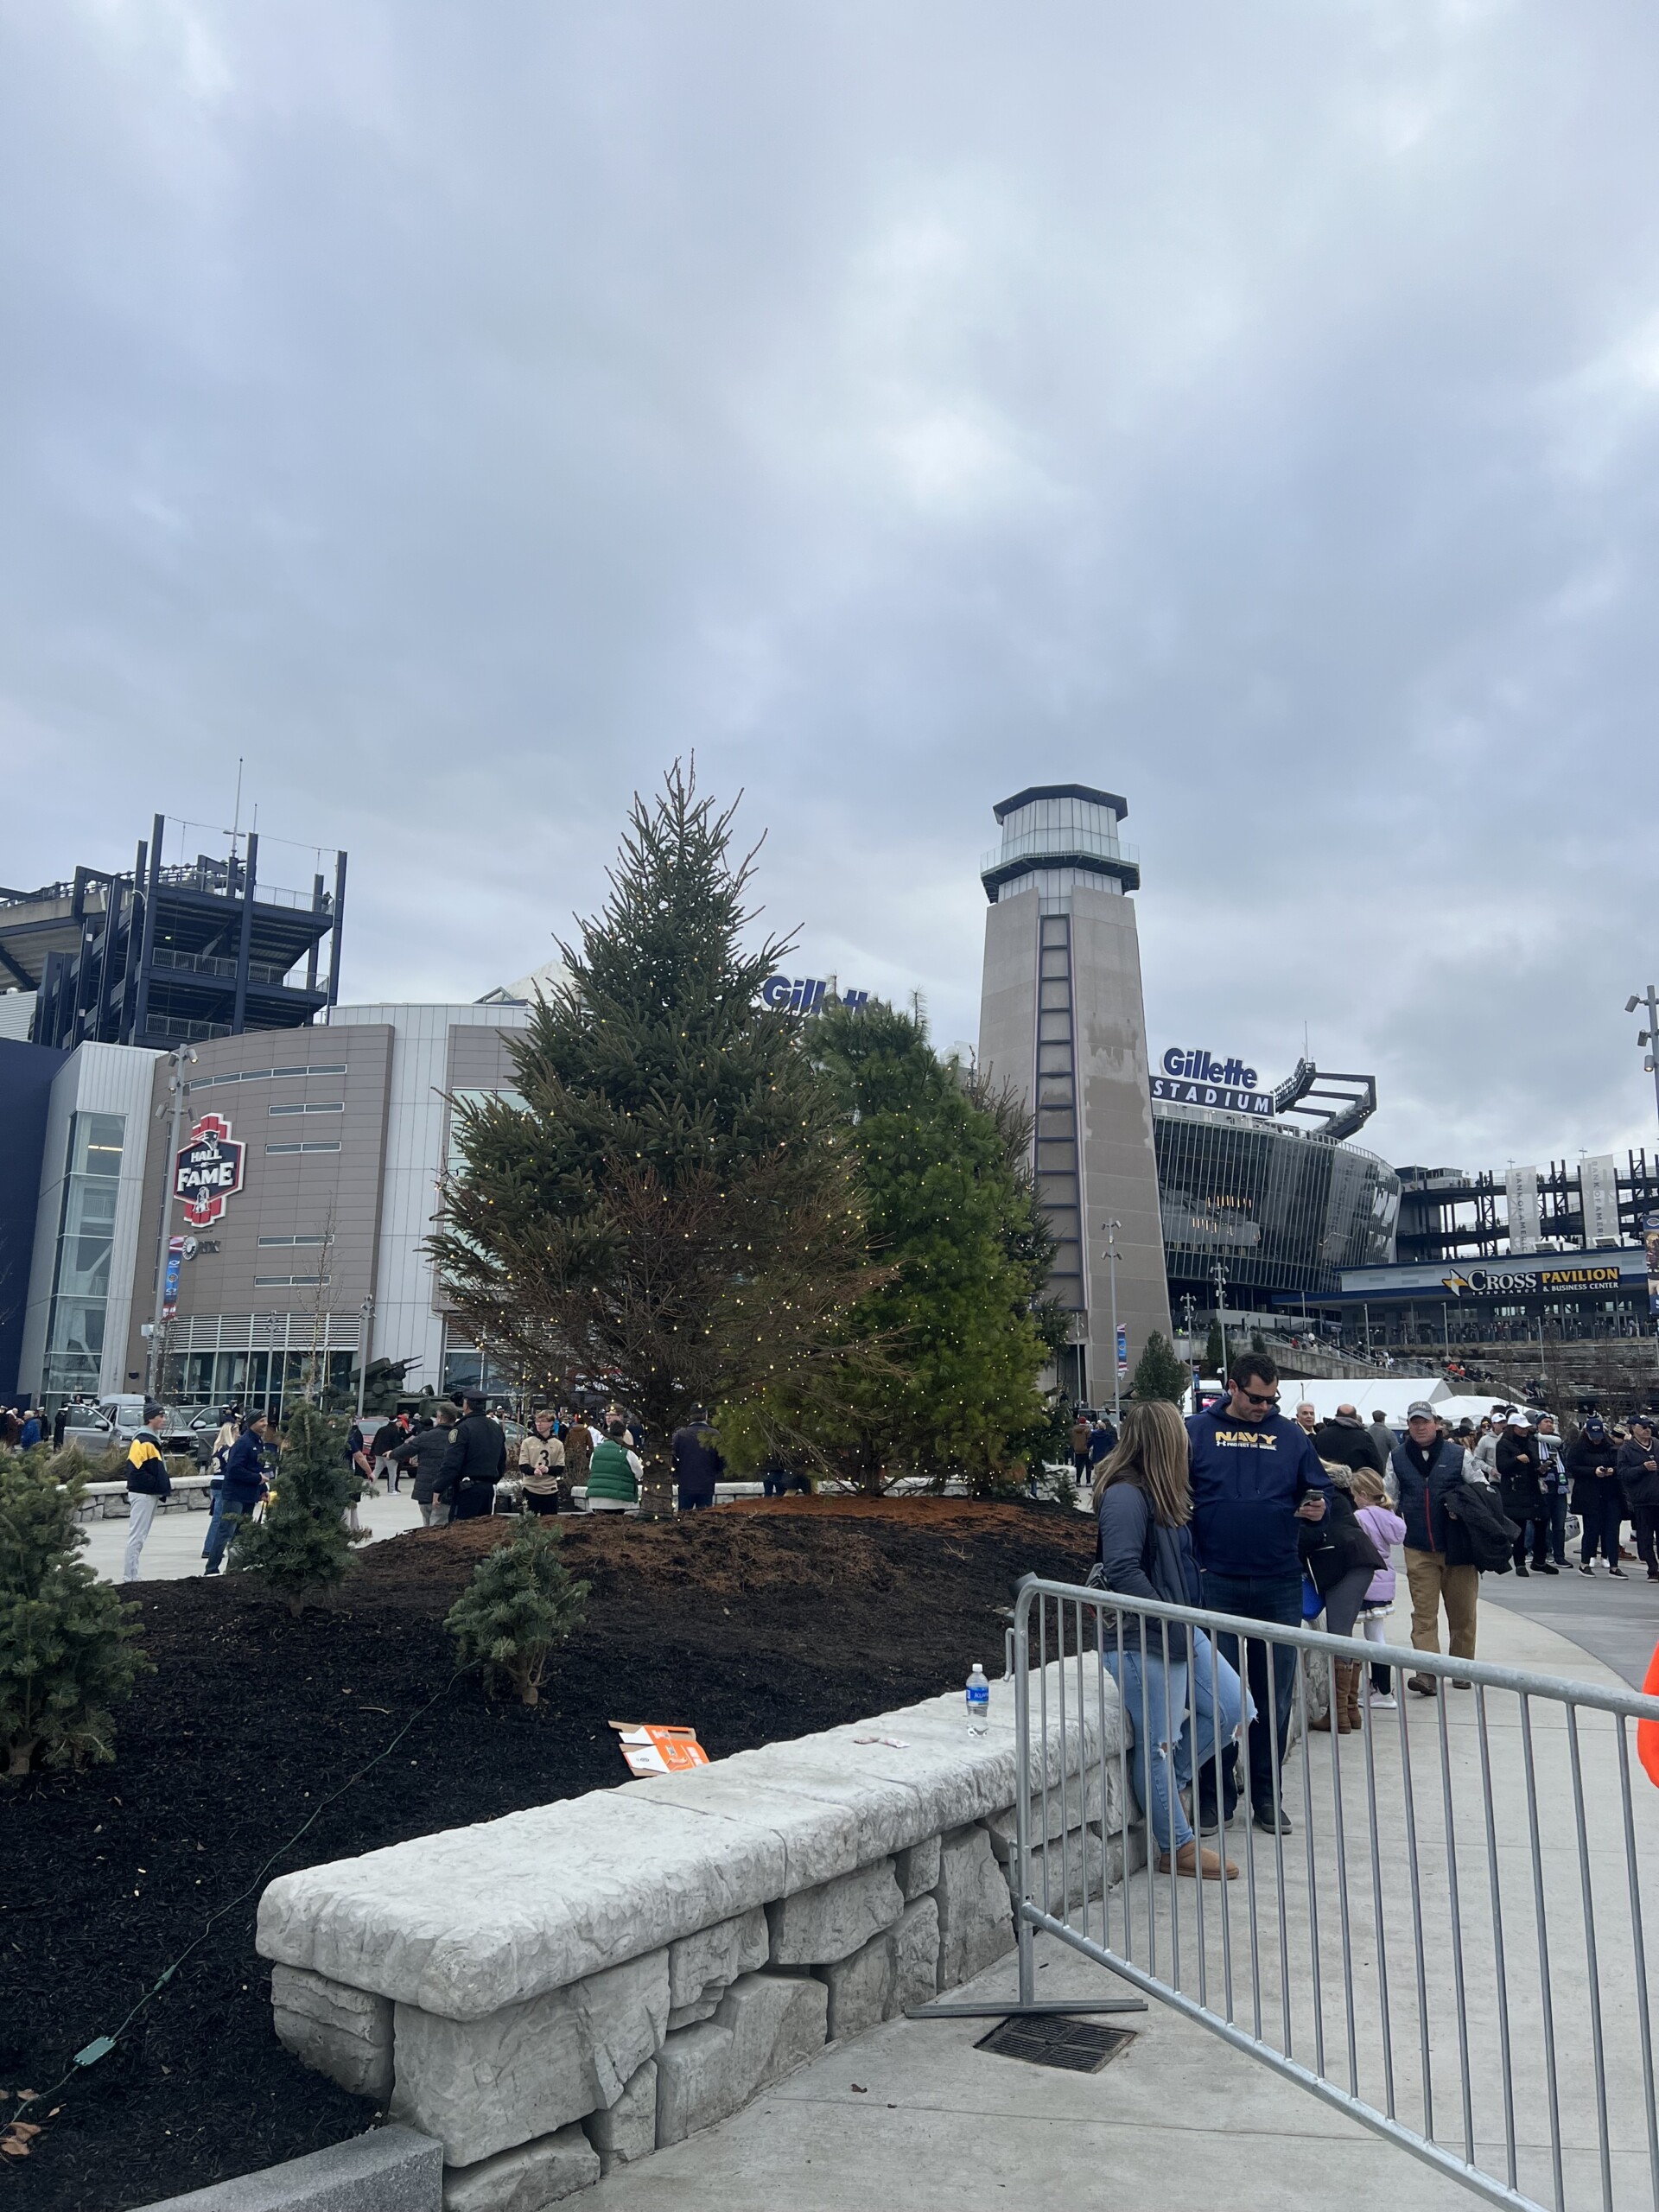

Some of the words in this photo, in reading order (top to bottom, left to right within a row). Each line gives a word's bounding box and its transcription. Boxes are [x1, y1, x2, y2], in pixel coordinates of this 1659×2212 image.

[1163, 1047, 1258, 1089] Gillette
[1153, 1080, 1269, 1113] STADIUM
[190, 1148, 222, 1162] HALL
[176, 1161, 234, 1192] FAME
[1592, 1160, 1600, 1188] BANK
[1517, 1200, 1525, 1211] OF
[1594, 1191, 1601, 1203] OF
[1595, 1206, 1604, 1237] AMERI
[1518, 1215, 1528, 1252] AMERIC
[1468, 1270, 1537, 1291] CROSS
[1541, 1268, 1618, 1283] PAVILION
[1551, 1283, 1587, 1292] BUSINESS
[1472, 1287, 1536, 1296] INSURANCE
[1215, 1431, 1277, 1445] NAVY
[540, 1449, 549, 1466] 3
